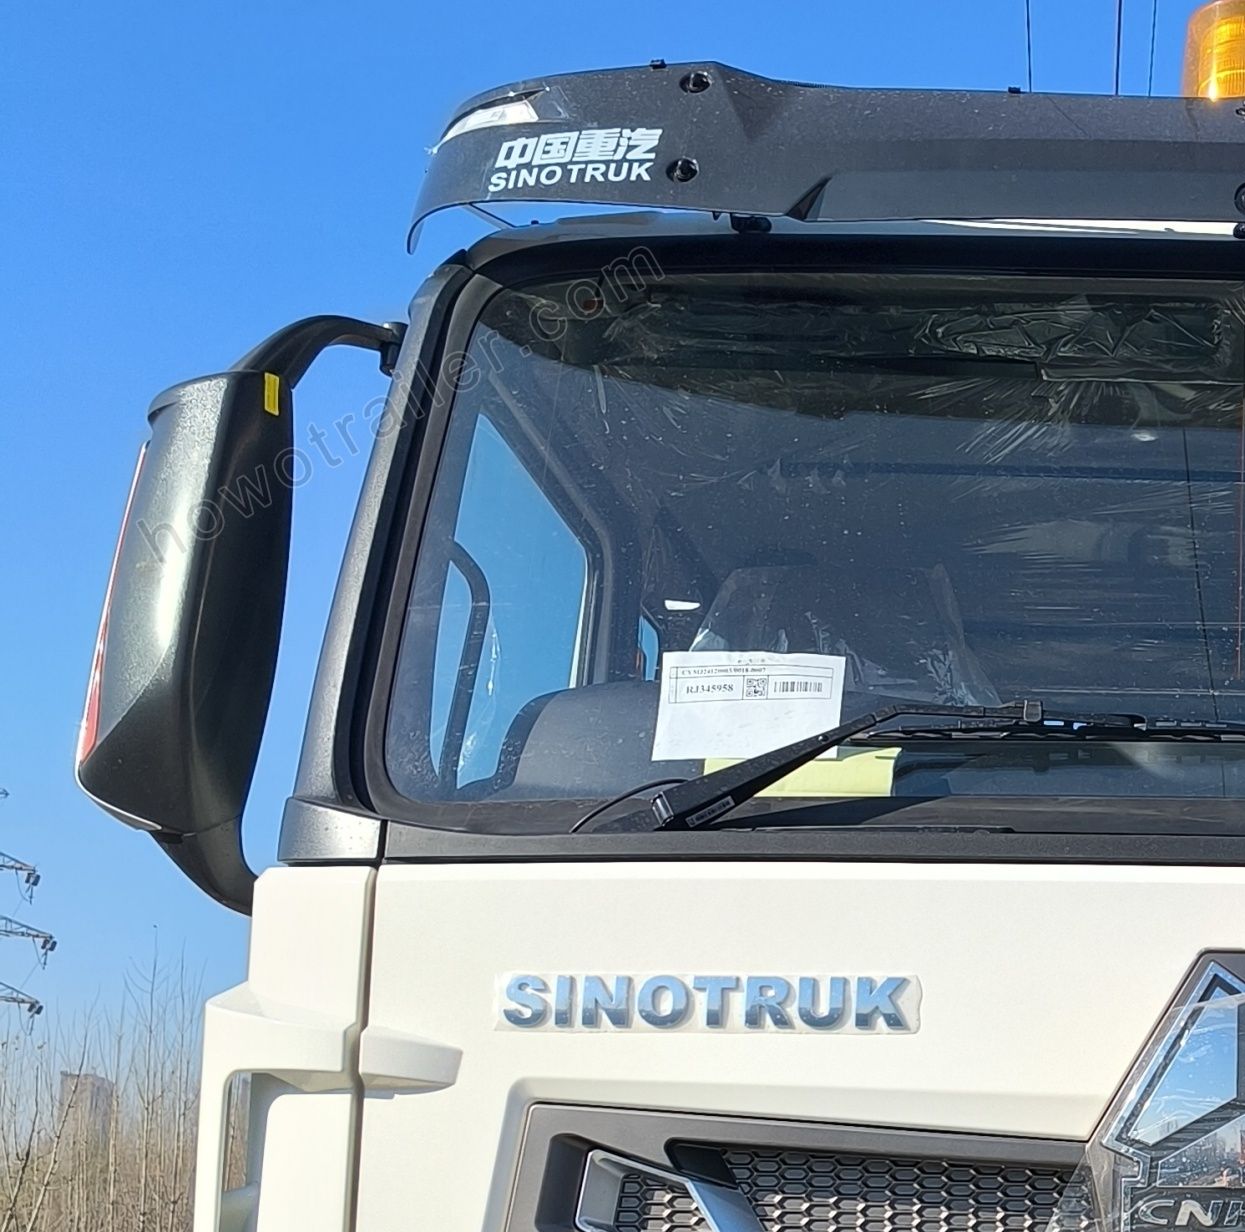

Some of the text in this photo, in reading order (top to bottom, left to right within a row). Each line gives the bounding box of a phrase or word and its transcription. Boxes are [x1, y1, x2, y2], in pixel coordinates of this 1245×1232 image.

[494, 127, 663, 170] 中国重汽
[488, 161, 654, 192] SINOTRUK
[502, 974, 912, 1031] SINOTRUK
